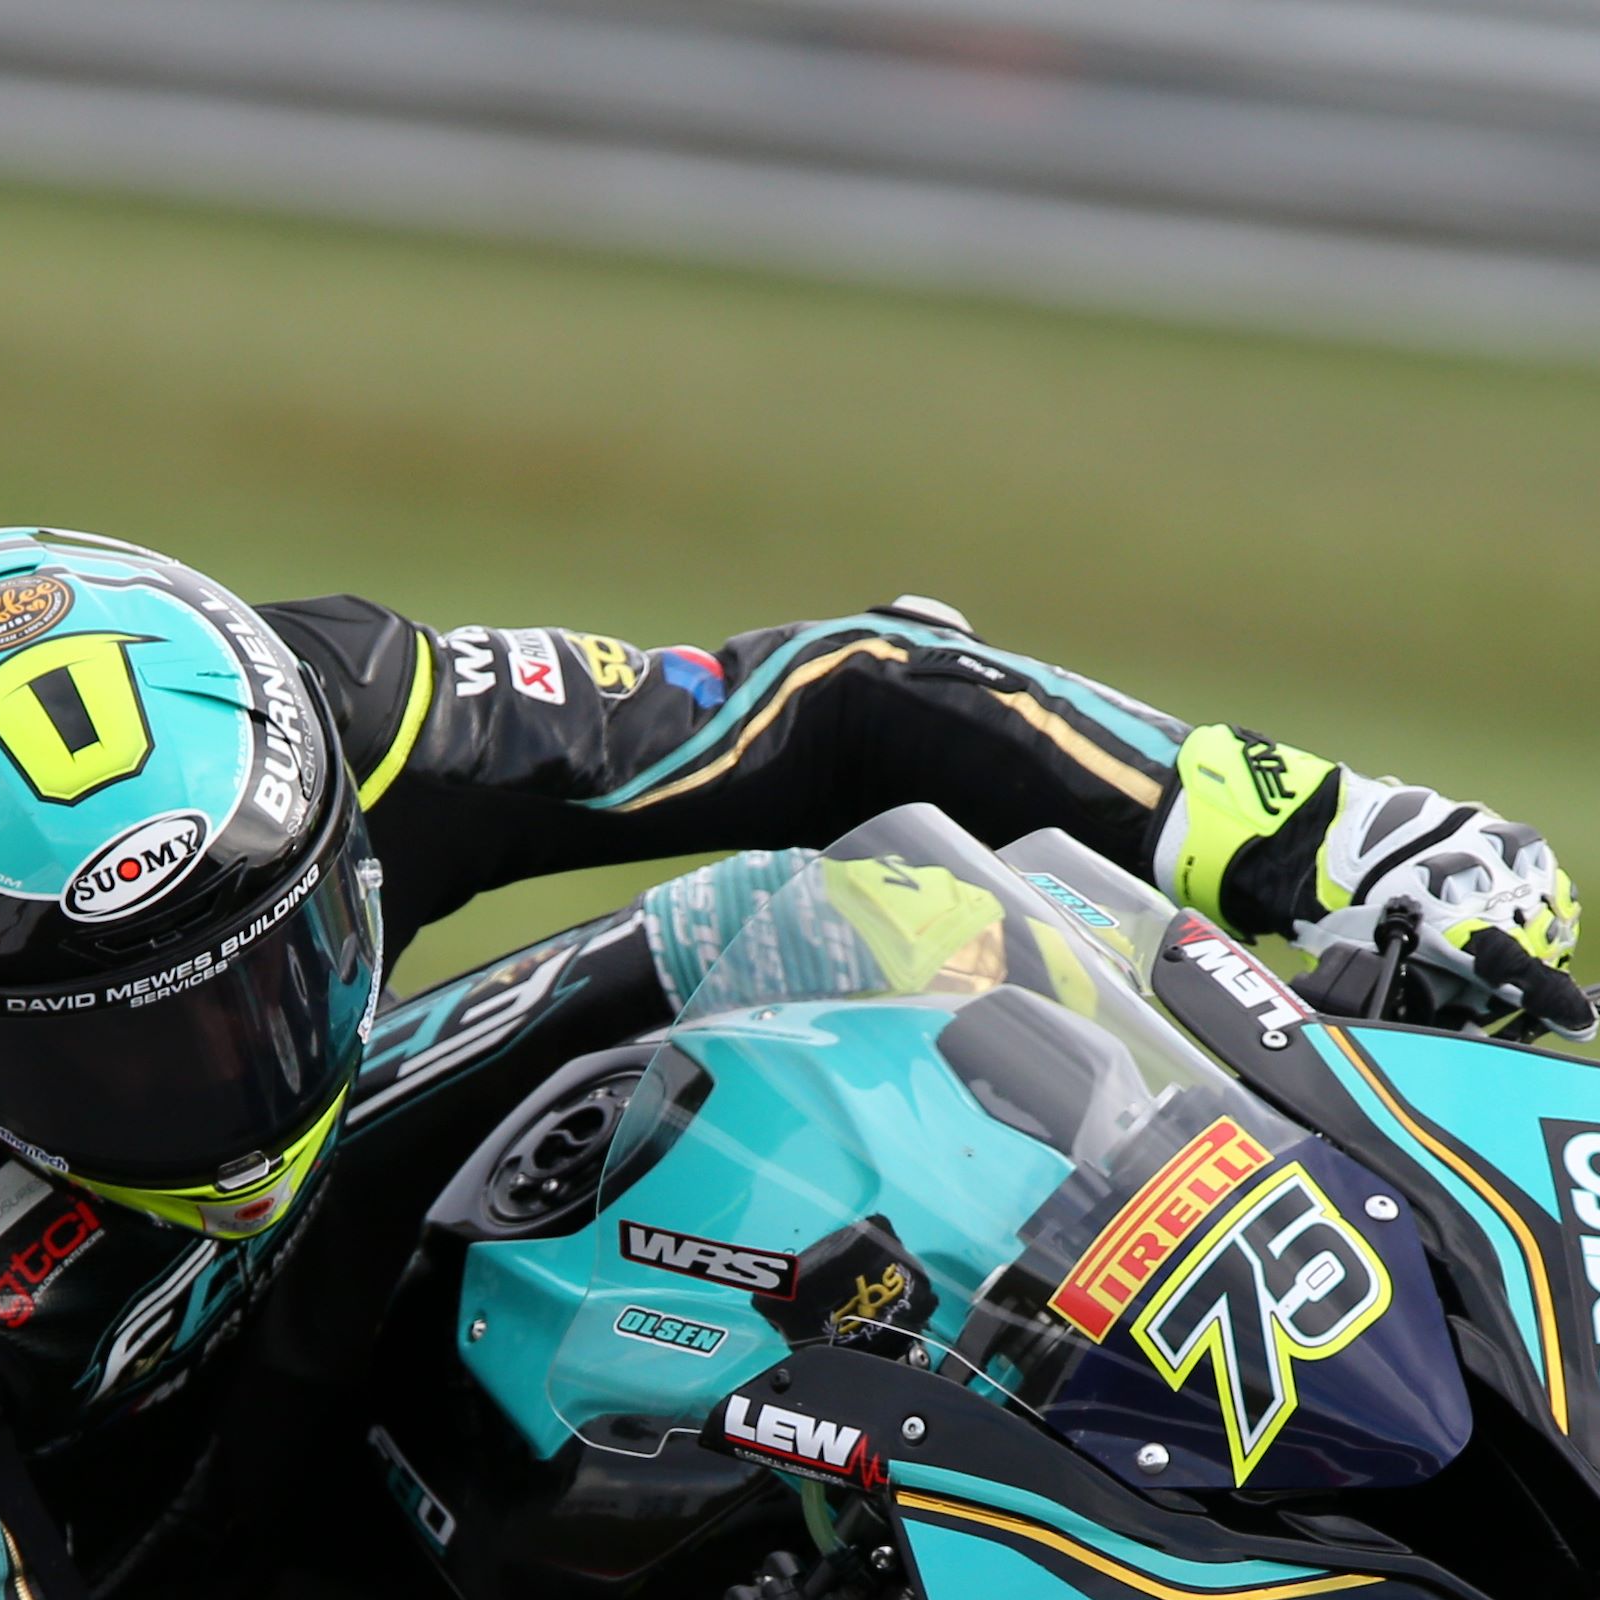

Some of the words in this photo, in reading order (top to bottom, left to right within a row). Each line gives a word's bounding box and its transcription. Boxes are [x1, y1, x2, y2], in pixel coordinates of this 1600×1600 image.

[73, 829, 197, 902] SUOMY
[6, 991, 96, 1013] DAVID
[106, 952, 212, 1003] MEWES
[221, 864, 320, 959] BUILDING
[1182, 938, 1303, 1031] LEW
[629, 1226, 789, 1290] WRS
[1052, 1121, 1267, 1339] PIRELLI
[618, 1310, 722, 1351] OLSEN
[1132, 1164, 1391, 1485] 75
[724, 1394, 861, 1468] LEW
